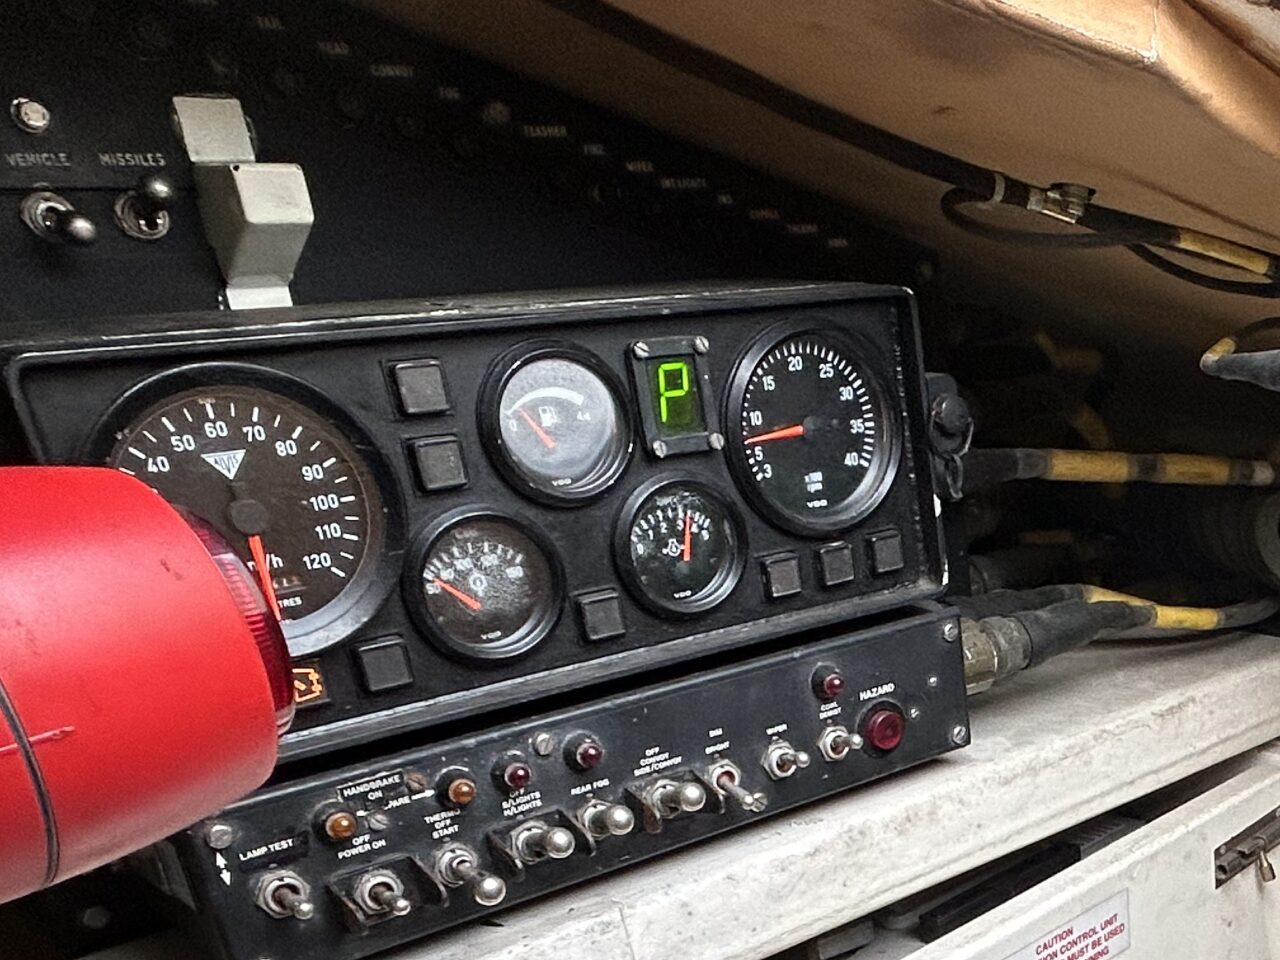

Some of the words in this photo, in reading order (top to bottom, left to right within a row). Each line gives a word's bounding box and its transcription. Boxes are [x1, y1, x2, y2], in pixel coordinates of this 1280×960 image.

[4, 151, 72, 168] VEHICLE
[98, 151, 166, 168] MISSILES
[787, 356, 803, 371] 20
[818, 363, 834, 379] 25
[762, 376, 776, 391] 15
[656, 362, 689, 424] P
[839, 387, 854, 401] 30
[749, 411, 763, 426] 10
[850, 419, 864, 434] 35
[203, 420, 229, 438] 60
[242, 424, 267, 444] 70
[170, 434, 196, 453] 50
[274, 439, 299, 457] 80
[754, 447, 764, 461] 5
[844, 452, 859, 467] 40
[146, 456, 170, 475] 40
[213, 454, 239, 474] ALVIS
[302, 463, 324, 481] 90
[763, 464, 772, 479] 3
[309, 493, 340, 511] 100
[806, 499, 828, 508] VDO
[315, 523, 341, 540] 110
[648, 529, 654, 541] 1
[659, 522, 668, 533] 2
[636, 544, 644, 555] 0
[303, 552, 331, 570] 120
[673, 590, 692, 599] VDO
[858, 682, 896, 702] HAZARD
[645, 746, 660, 757] OFF
[342, 774, 402, 798] HANDBRAKE
[570, 783, 592, 796] REAR
[593, 778, 610, 791] FOG
[367, 790, 384, 802] ON
[501, 791, 542, 809] S/LIGHTS
[432, 824, 460, 841] START
[434, 818, 452, 831] OFF
[352, 834, 371, 846] OFF
[238, 846, 267, 862] LAMP
[267, 838, 294, 854] TEST
[337, 843, 371, 860] POWER
[371, 839, 387, 851] ON
[1035, 926, 1074, 956] CAUTION
[1059, 925, 1098, 955] CONTROL
[1100, 912, 1119, 932] UNIT
[1091, 937, 1103, 951] BE
[1104, 923, 1126, 943] USED
